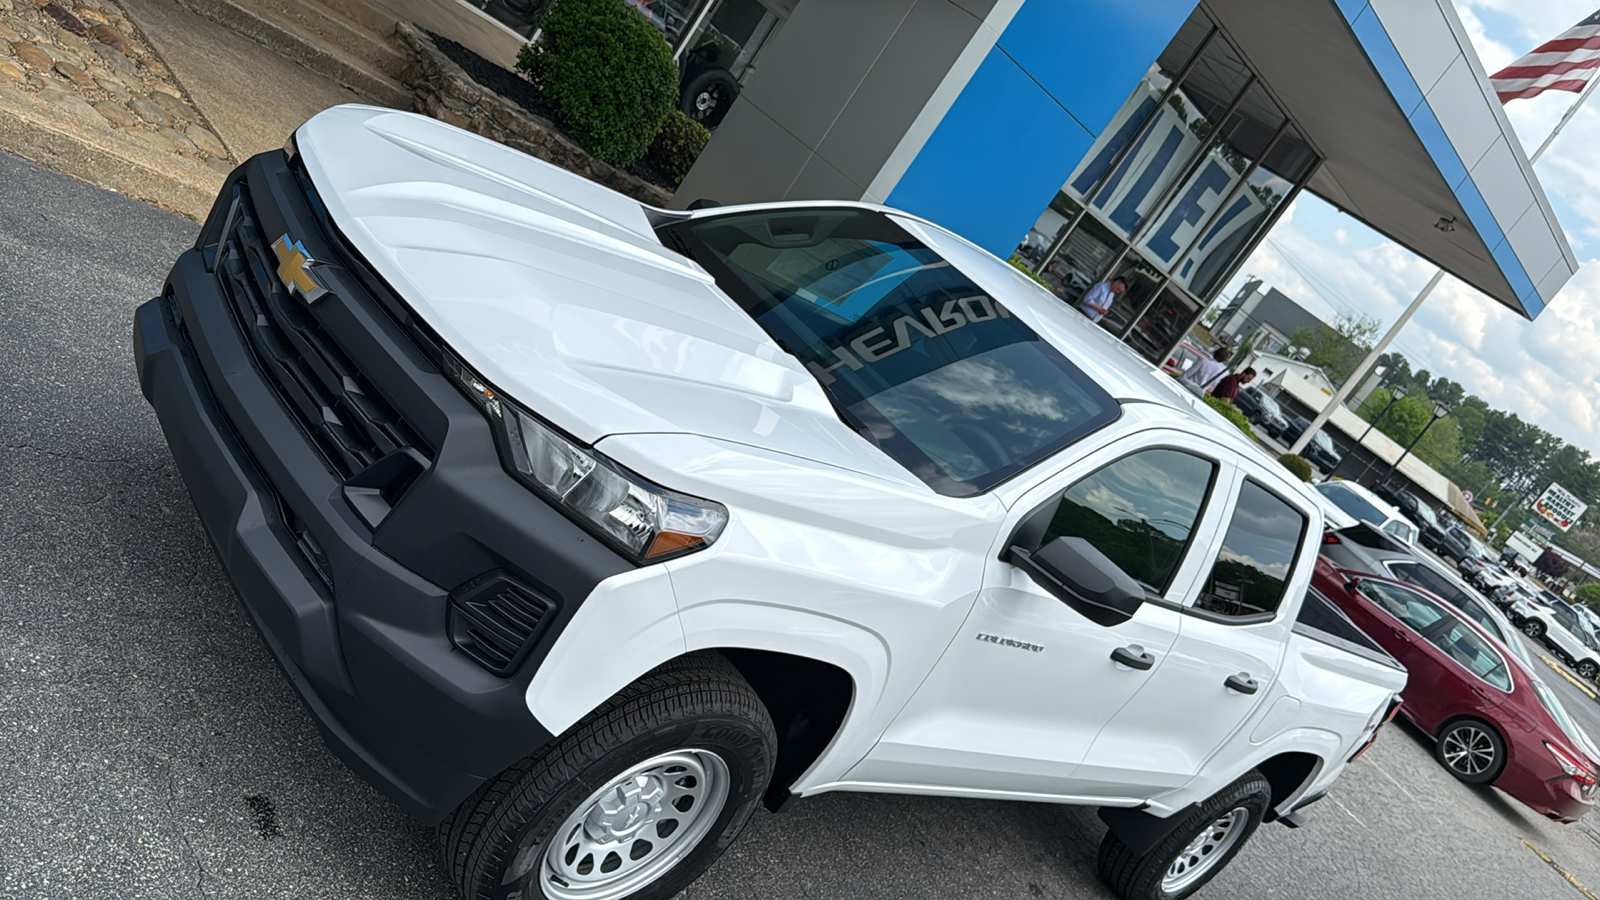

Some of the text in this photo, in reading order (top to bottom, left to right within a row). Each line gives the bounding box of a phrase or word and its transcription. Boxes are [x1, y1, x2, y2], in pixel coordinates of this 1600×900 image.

[1546, 496, 1576, 517] HARVEST
[1548, 489, 1576, 510] HEALTHY
[1544, 501, 1574, 524] PRODUCE
